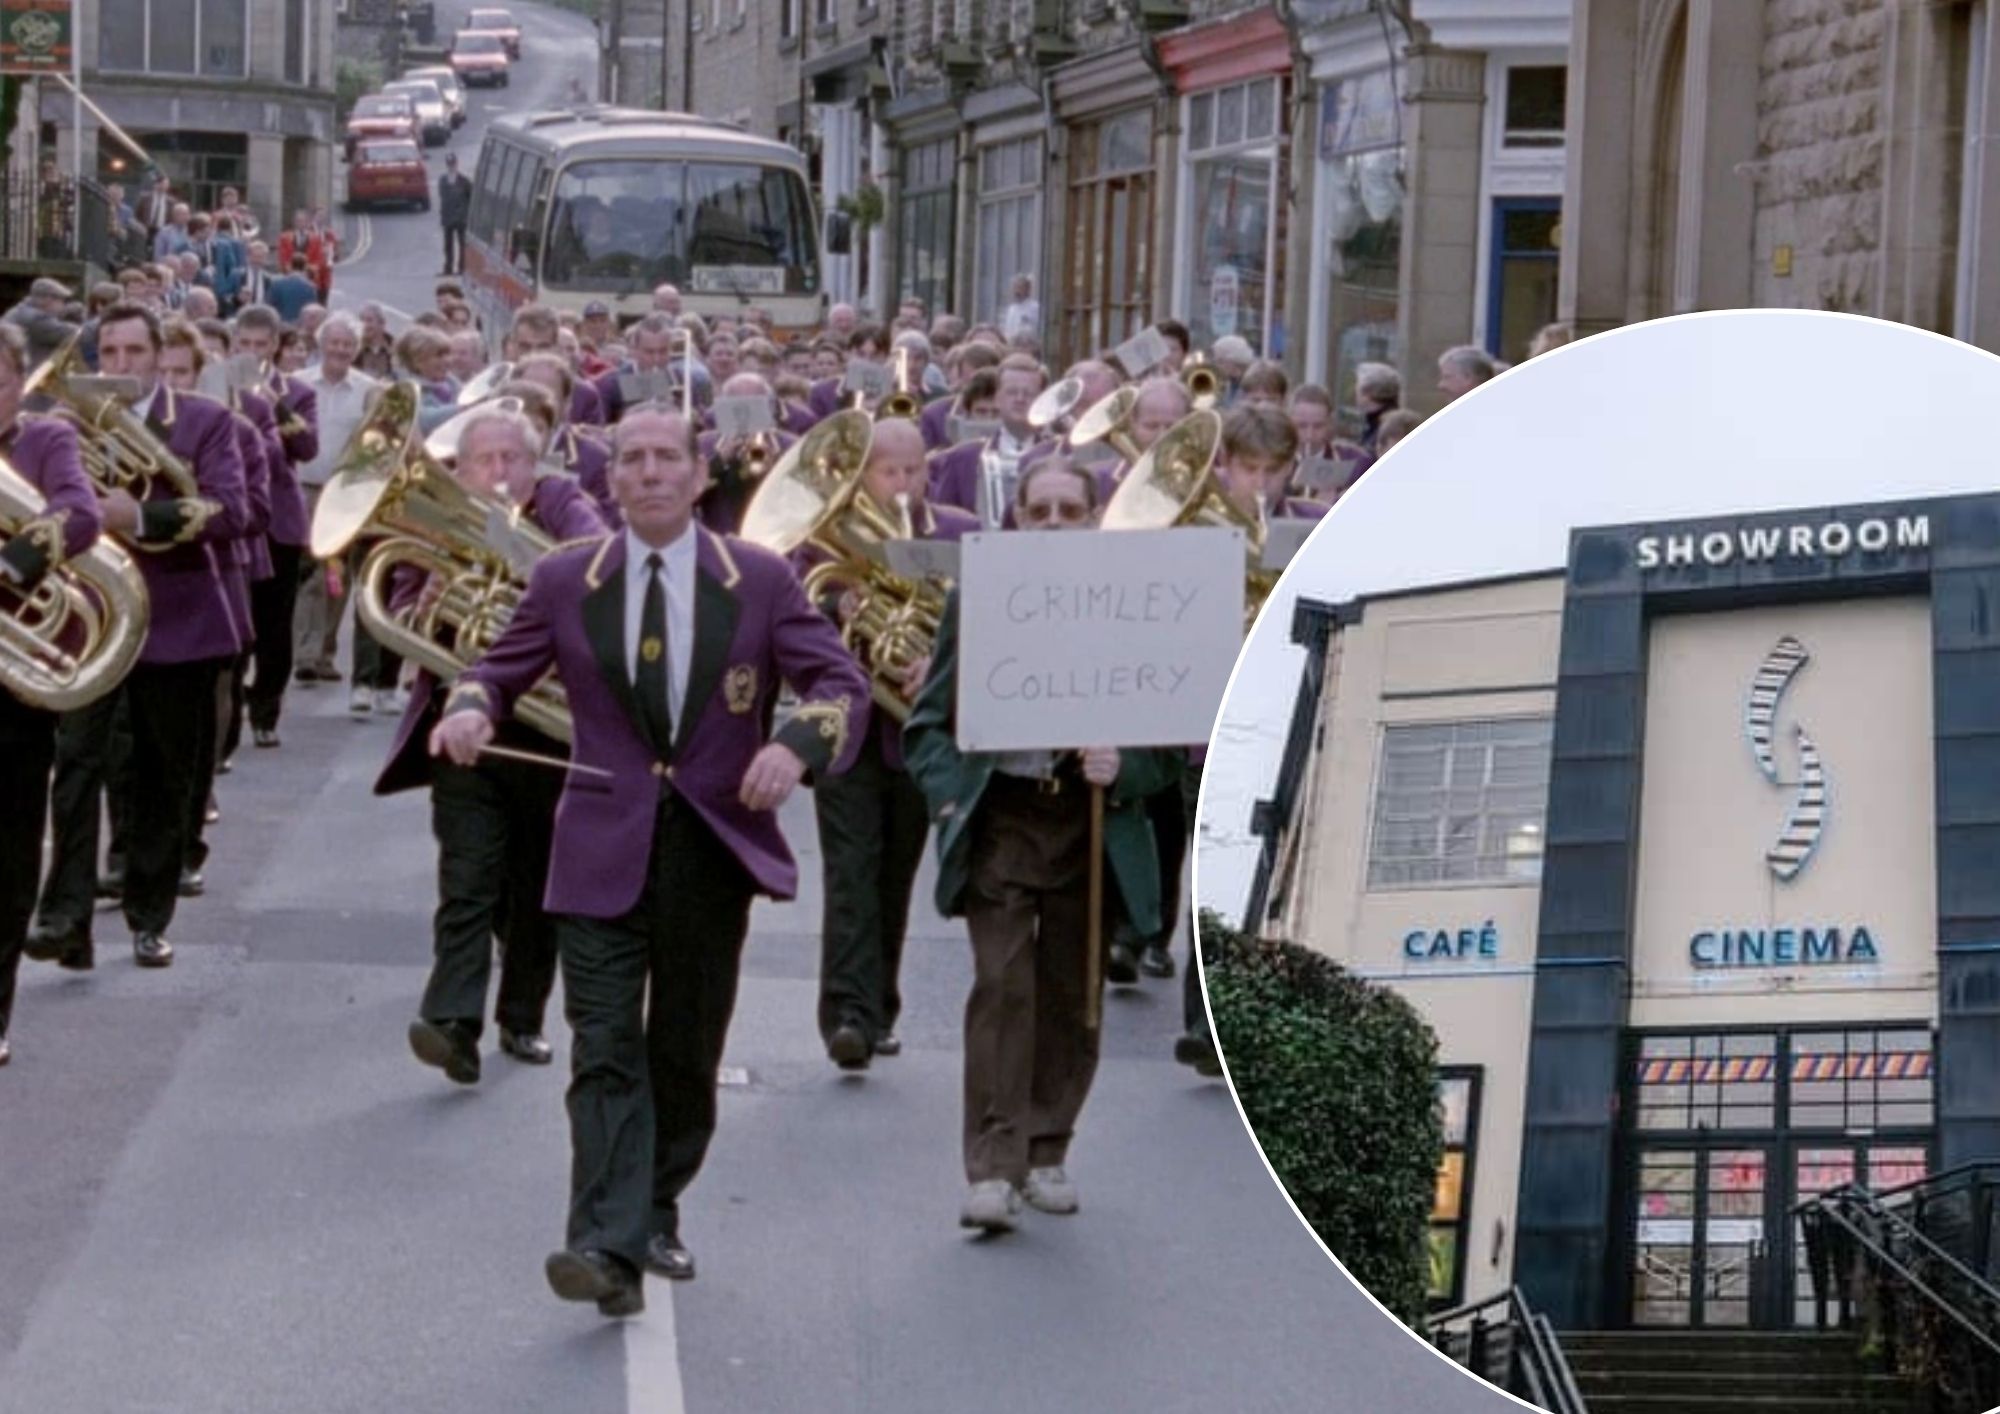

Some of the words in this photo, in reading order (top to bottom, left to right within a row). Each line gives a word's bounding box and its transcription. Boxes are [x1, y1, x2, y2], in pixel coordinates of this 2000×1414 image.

[1637, 515, 1929, 567] SHOWROOM
[1007, 582, 1198, 623] GRIMLEY
[986, 657, 1190, 700] COLLIERY
[1404, 920, 1497, 957] CAFÉ
[1690, 925, 1878, 965] CINEMA
